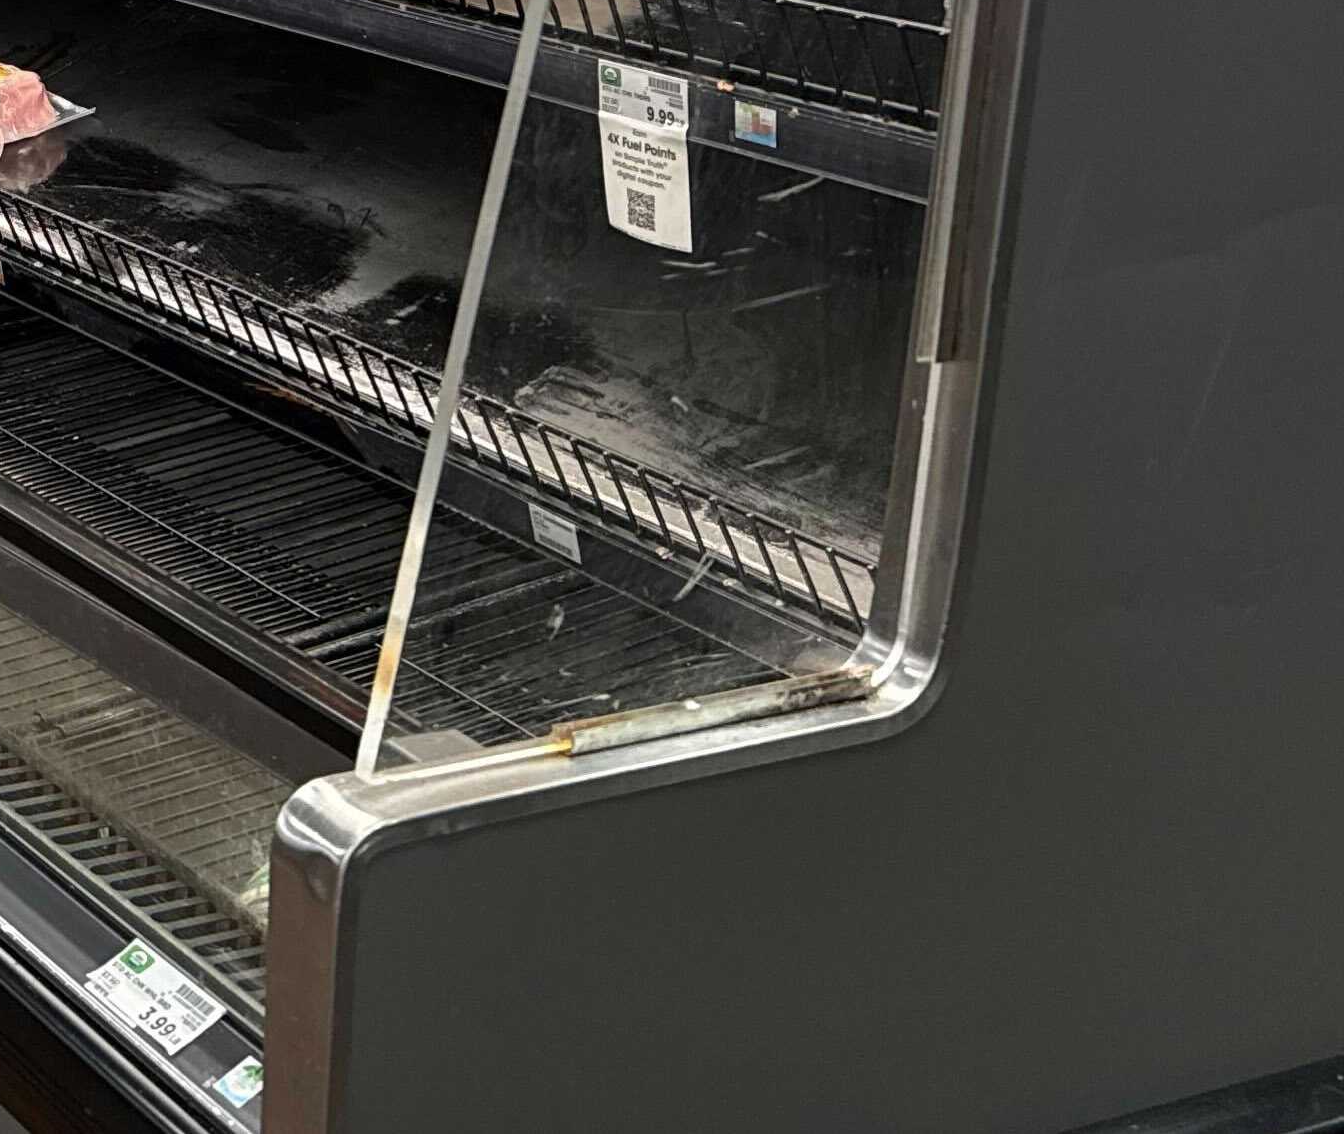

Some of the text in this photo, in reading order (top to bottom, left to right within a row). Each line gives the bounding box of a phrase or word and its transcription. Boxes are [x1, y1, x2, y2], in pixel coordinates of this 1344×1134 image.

[647, 105, 675, 127] 9.99
[607, 132, 677, 161] 4X Fuel Points
[138, 1005, 177, 1037] 3.99
